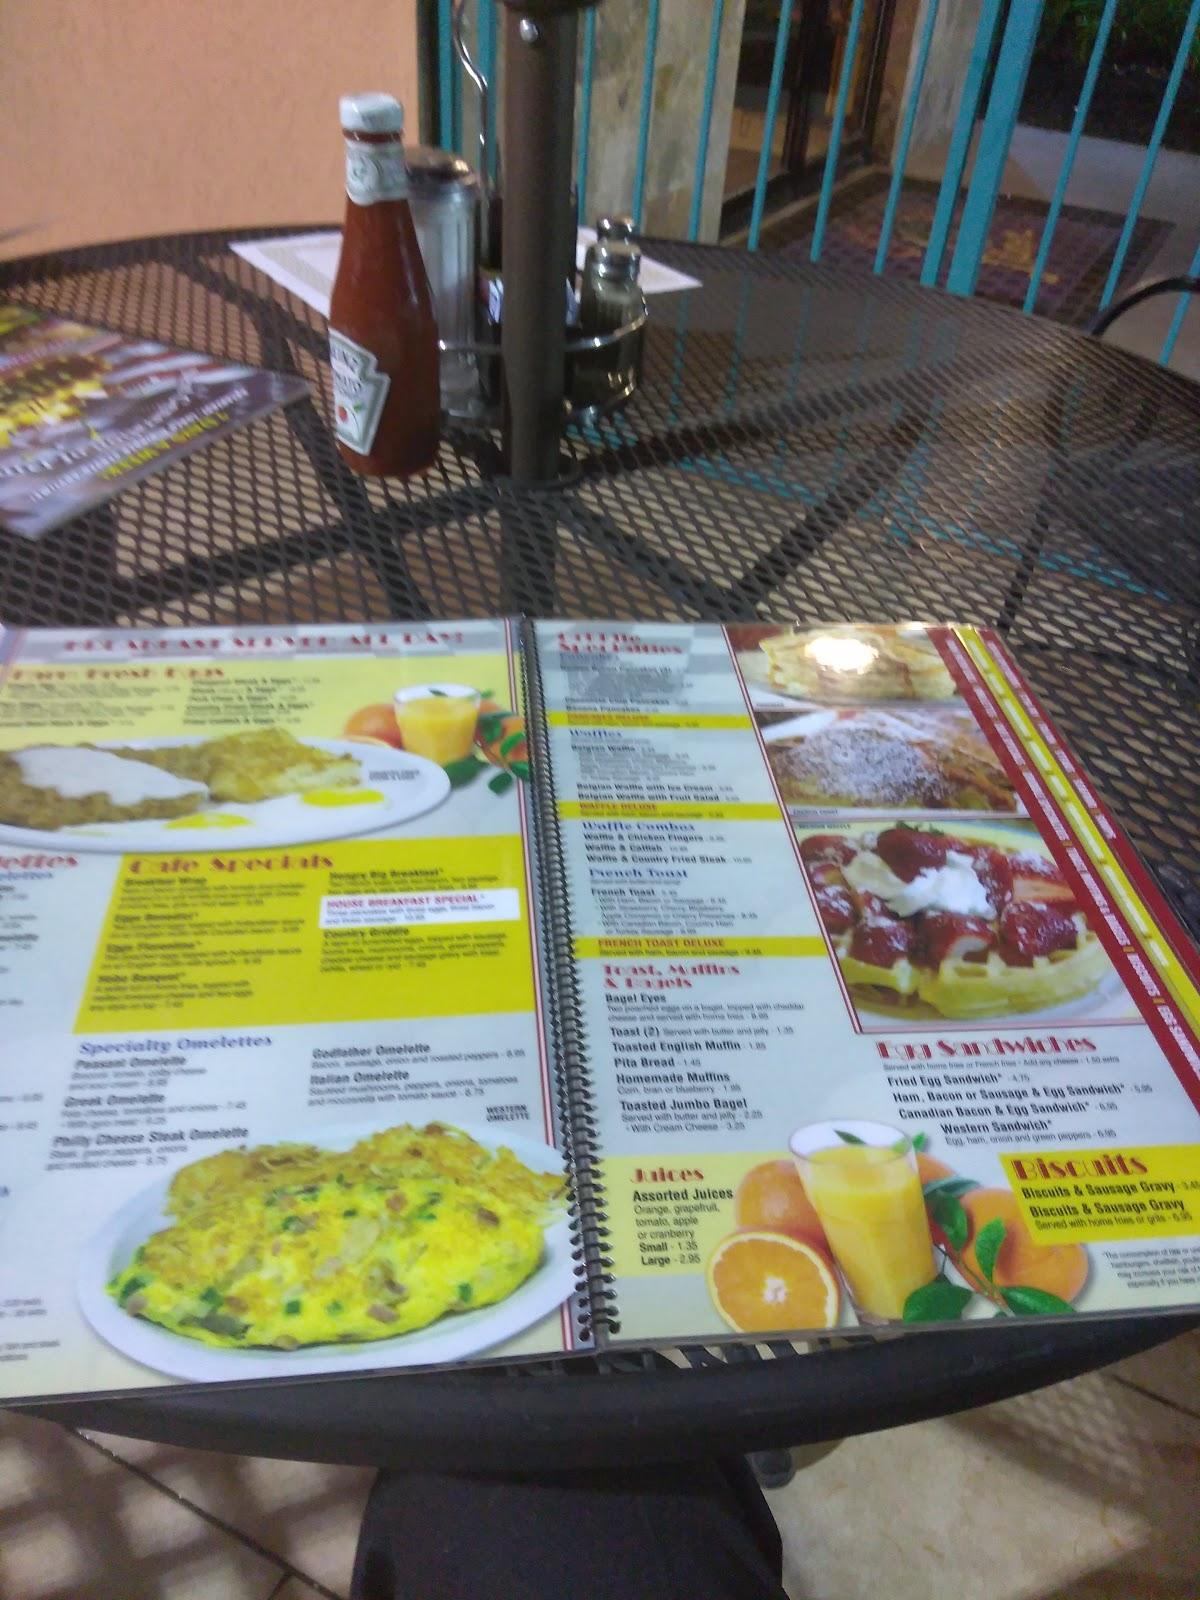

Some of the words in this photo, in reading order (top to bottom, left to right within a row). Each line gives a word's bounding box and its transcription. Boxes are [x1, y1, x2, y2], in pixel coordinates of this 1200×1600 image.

[611, 1028, 639, 1037] Toast
[644, 1027, 659, 1037] (2)
[613, 1043, 656, 1052] Toasted
[660, 1042, 702, 1053] English
[706, 1042, 741, 1050] Muffin
[876, 1041, 932, 1060] Egg
[936, 1036, 1097, 1056] Sandwiches
[614, 1058, 637, 1068] Pita
[641, 1057, 675, 1067] Bread
[617, 1073, 683, 1084] Homemade
[688, 1072, 730, 1082] Muffins
[888, 1076, 917, 1087] Fried
[920, 1076, 942, 1088] Egg
[893, 1092, 924, 1104] Ham,
[928, 1090, 963, 1101] Bacon
[980, 1088, 1028, 1100] Sausage
[1032, 1088, 1040, 1098] &
[1044, 1086, 1065, 1099] Egg
[620, 1101, 666, 1111] Toasted
[671, 1100, 710, 1111] Jumbo
[714, 1099, 748, 1111] Bagel
[899, 1108, 954, 1120] Canadian
[957, 1106, 991, 1117] Bacon
[995, 1105, 1003, 1115] &
[1007, 1104, 1028, 1117] Egg
[941, 1122, 989, 1134] Western
[1011, 1153, 1148, 1181] Biscuits
[633, 1189, 688, 1202] Assorted
[692, 1188, 734, 1200] Juices
[1021, 1186, 1071, 1199] Biscuits
[1074, 1185, 1083, 1196] &
[1086, 1183, 1138, 1198] Sausage
[1140, 1181, 1175, 1194] Gravy
[634, 1205, 671, 1216] Orange,
[674, 1203, 720, 1215] grapefruit,
[1029, 1204, 1079, 1218] Biscuits
[1082, 1203, 1091, 1215] &
[1094, 1201, 1147, 1215] Sausage
[1149, 1199, 1185, 1212] Gravy
[673, 1216, 698, 1226] apple
[638, 1231, 647, 1239] or
[650, 1228, 694, 1239] cranberry
[640, 1242, 668, 1252] Small
[641, 1255, 670, 1267] Large
